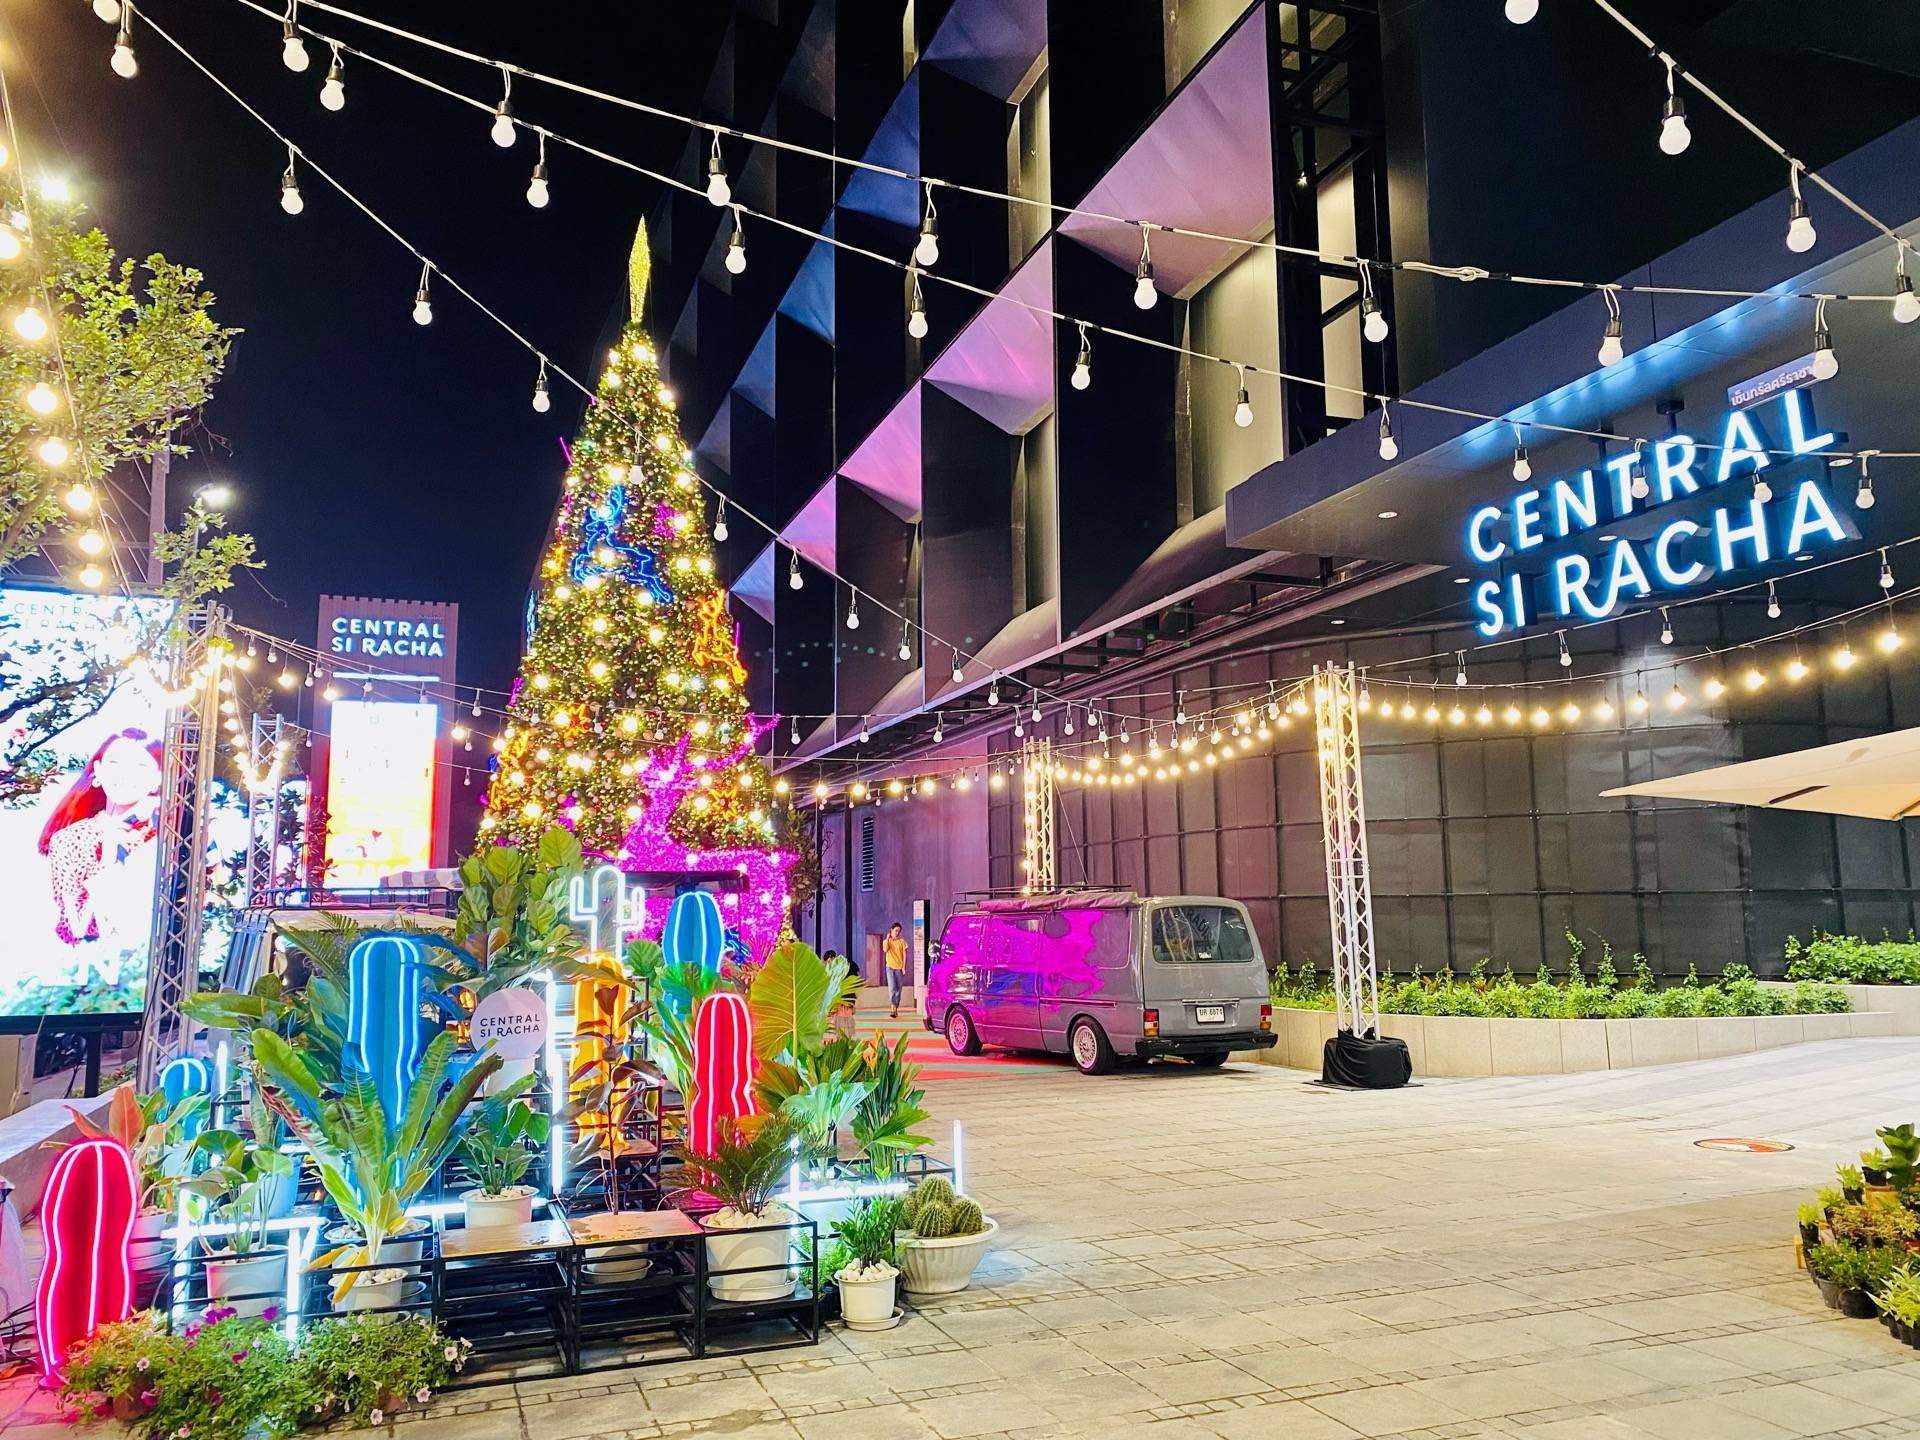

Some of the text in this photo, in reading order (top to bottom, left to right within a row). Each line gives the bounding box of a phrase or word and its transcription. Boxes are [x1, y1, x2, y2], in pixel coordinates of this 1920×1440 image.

[1469, 389, 1835, 563] CENTRAL
[1477, 479, 1847, 637] SI RACHA
[331, 617, 445, 639] CENTRAL
[331, 636, 443, 657] SI RACHA
[480, 1014, 541, 1027] CENTRAL
[480, 1025, 540, 1038] SI RACHA
